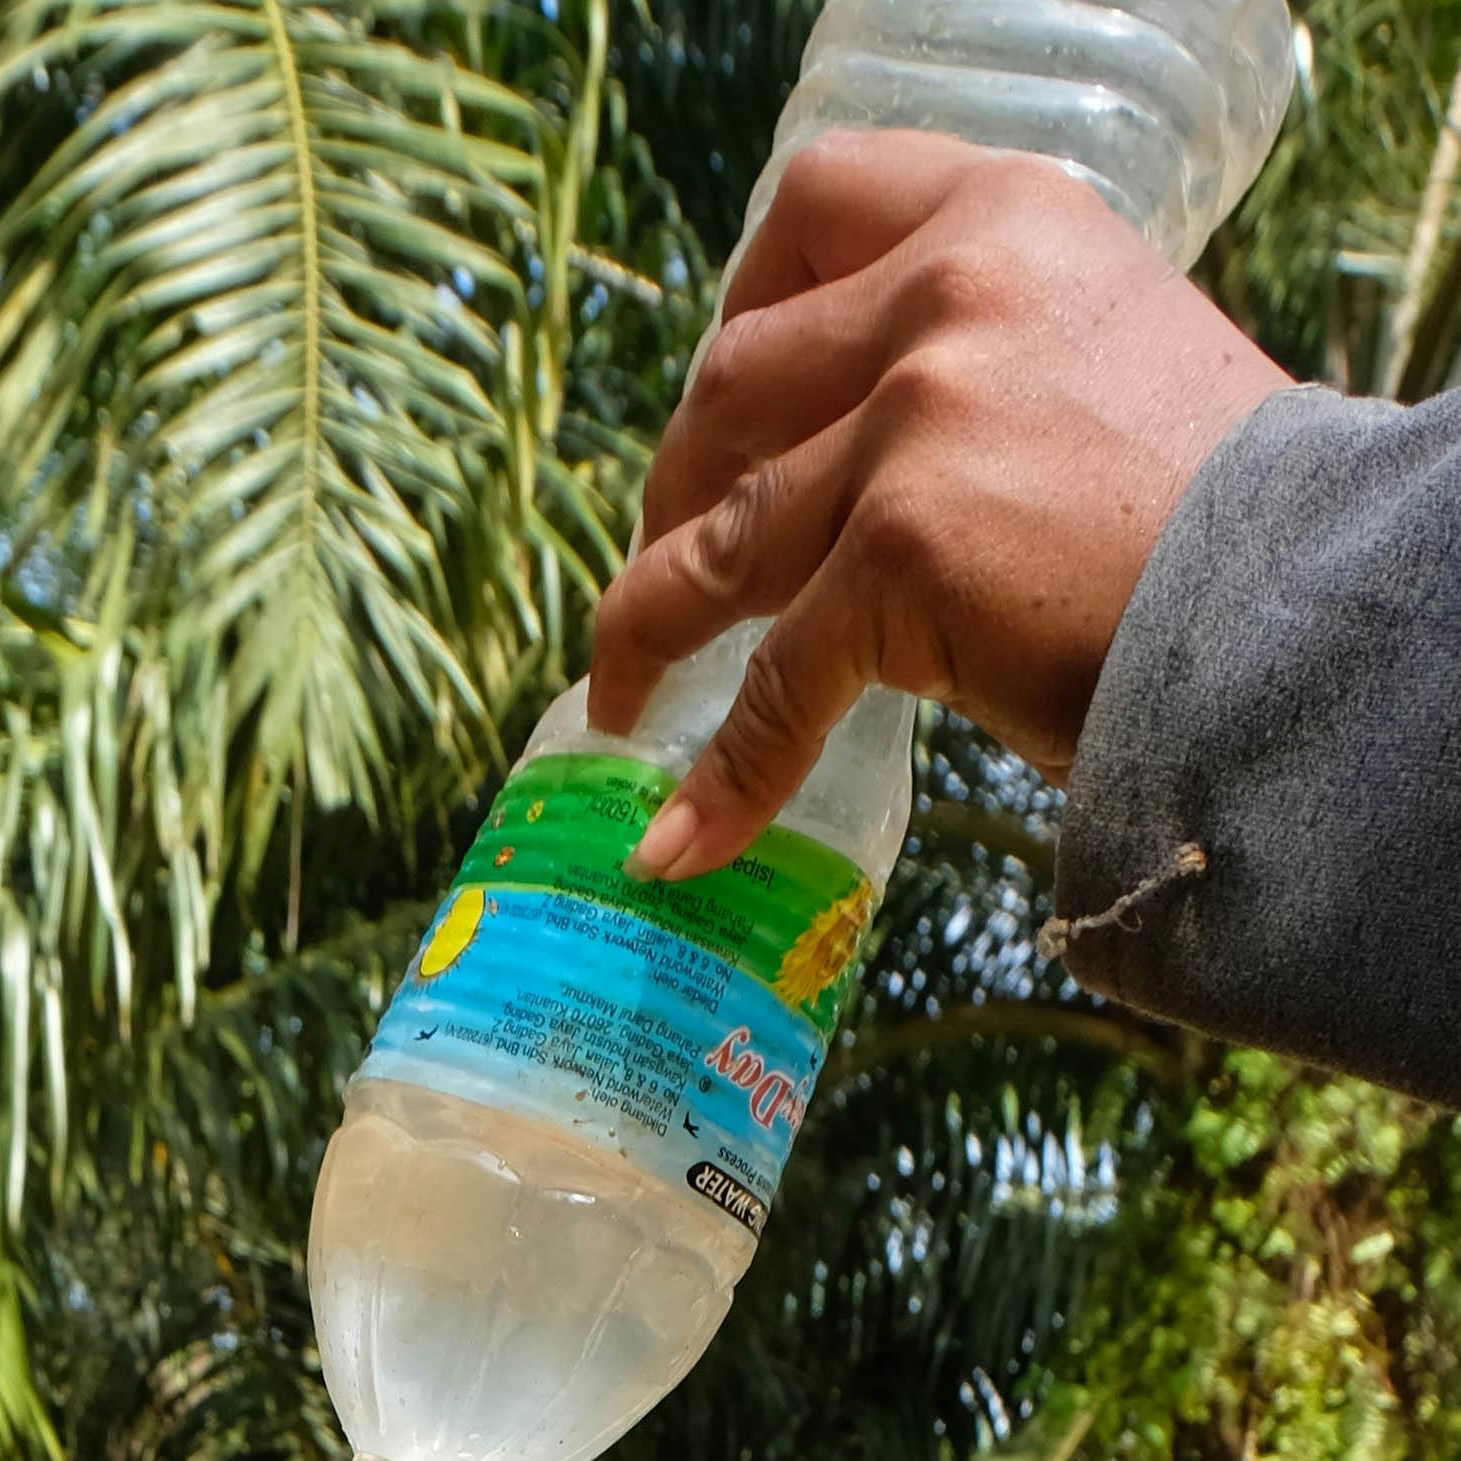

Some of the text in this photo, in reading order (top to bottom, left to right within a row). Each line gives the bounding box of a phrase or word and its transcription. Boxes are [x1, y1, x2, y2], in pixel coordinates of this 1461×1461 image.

[731, 855, 775, 889] Isipa
[552, 892, 598, 921] Gading
[600, 911, 634, 932] Jaya
[602, 929, 656, 962] Network
[636, 926, 672, 951] Jalan
[683, 929, 739, 967] Kawasan
[687, 949, 699, 965] &
[699, 955, 710, 971] 6
[658, 953, 725, 998] Waterworld
[502, 1018, 547, 1046] Gading
[548, 1017, 581, 1037] Jaya
[569, 1007, 614, 1034] 26070
[618, 1007, 652, 1033] Darul
[550, 1035, 582, 1058] Jaya
[654, 1021, 701, 1057] Pahang
[549, 1054, 603, 1087] Network
[585, 1049, 619, 1073] Jalan
[631, 1052, 685, 1090] Kawasan
[665, 1050, 693, 1073] Jaya
[634, 1071, 647, 1088] &
[647, 1079, 658, 1094] 6
[605, 1076, 672, 1122] Waterworld
[619, 1099, 667, 1137] Dikilang
[715, 1145, 757, 1182] Process
[695, 1165, 759, 1219] WATER
